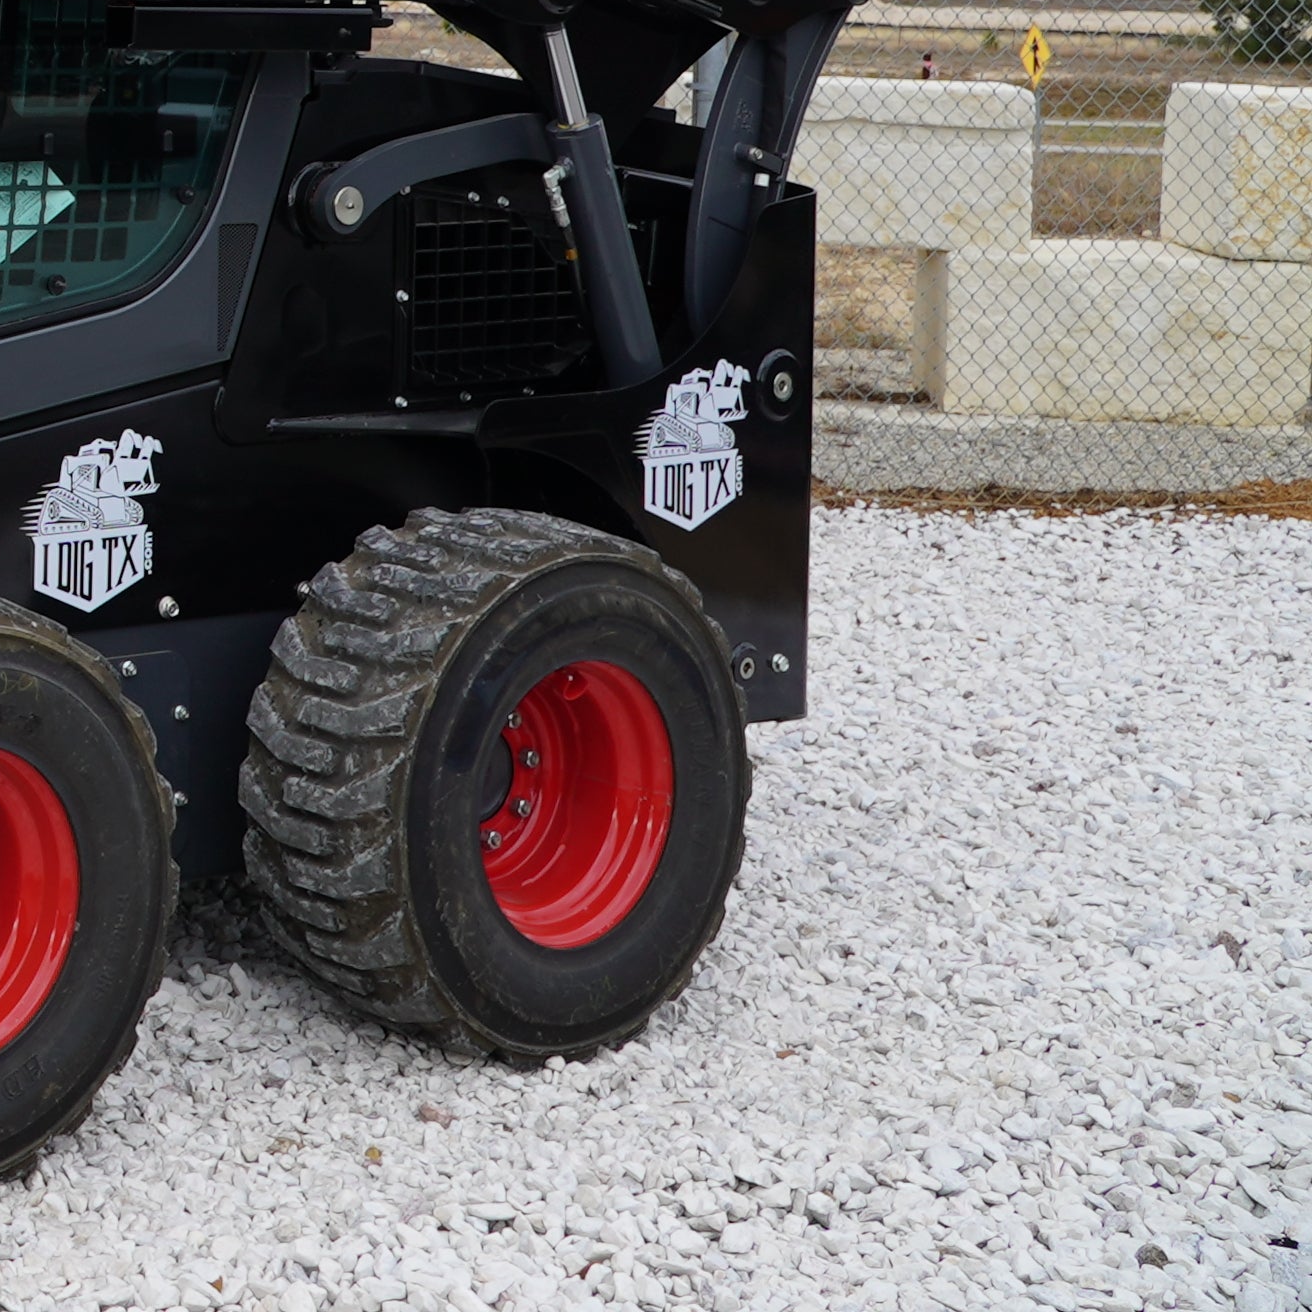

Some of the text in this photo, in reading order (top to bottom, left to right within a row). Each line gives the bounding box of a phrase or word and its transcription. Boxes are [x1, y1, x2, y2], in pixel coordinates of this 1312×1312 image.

[650, 457, 731, 521] I DIG TX
[735, 455, 744, 496] .com
[41, 534, 139, 601] I DIG TX
[144, 531, 154, 576] .com
